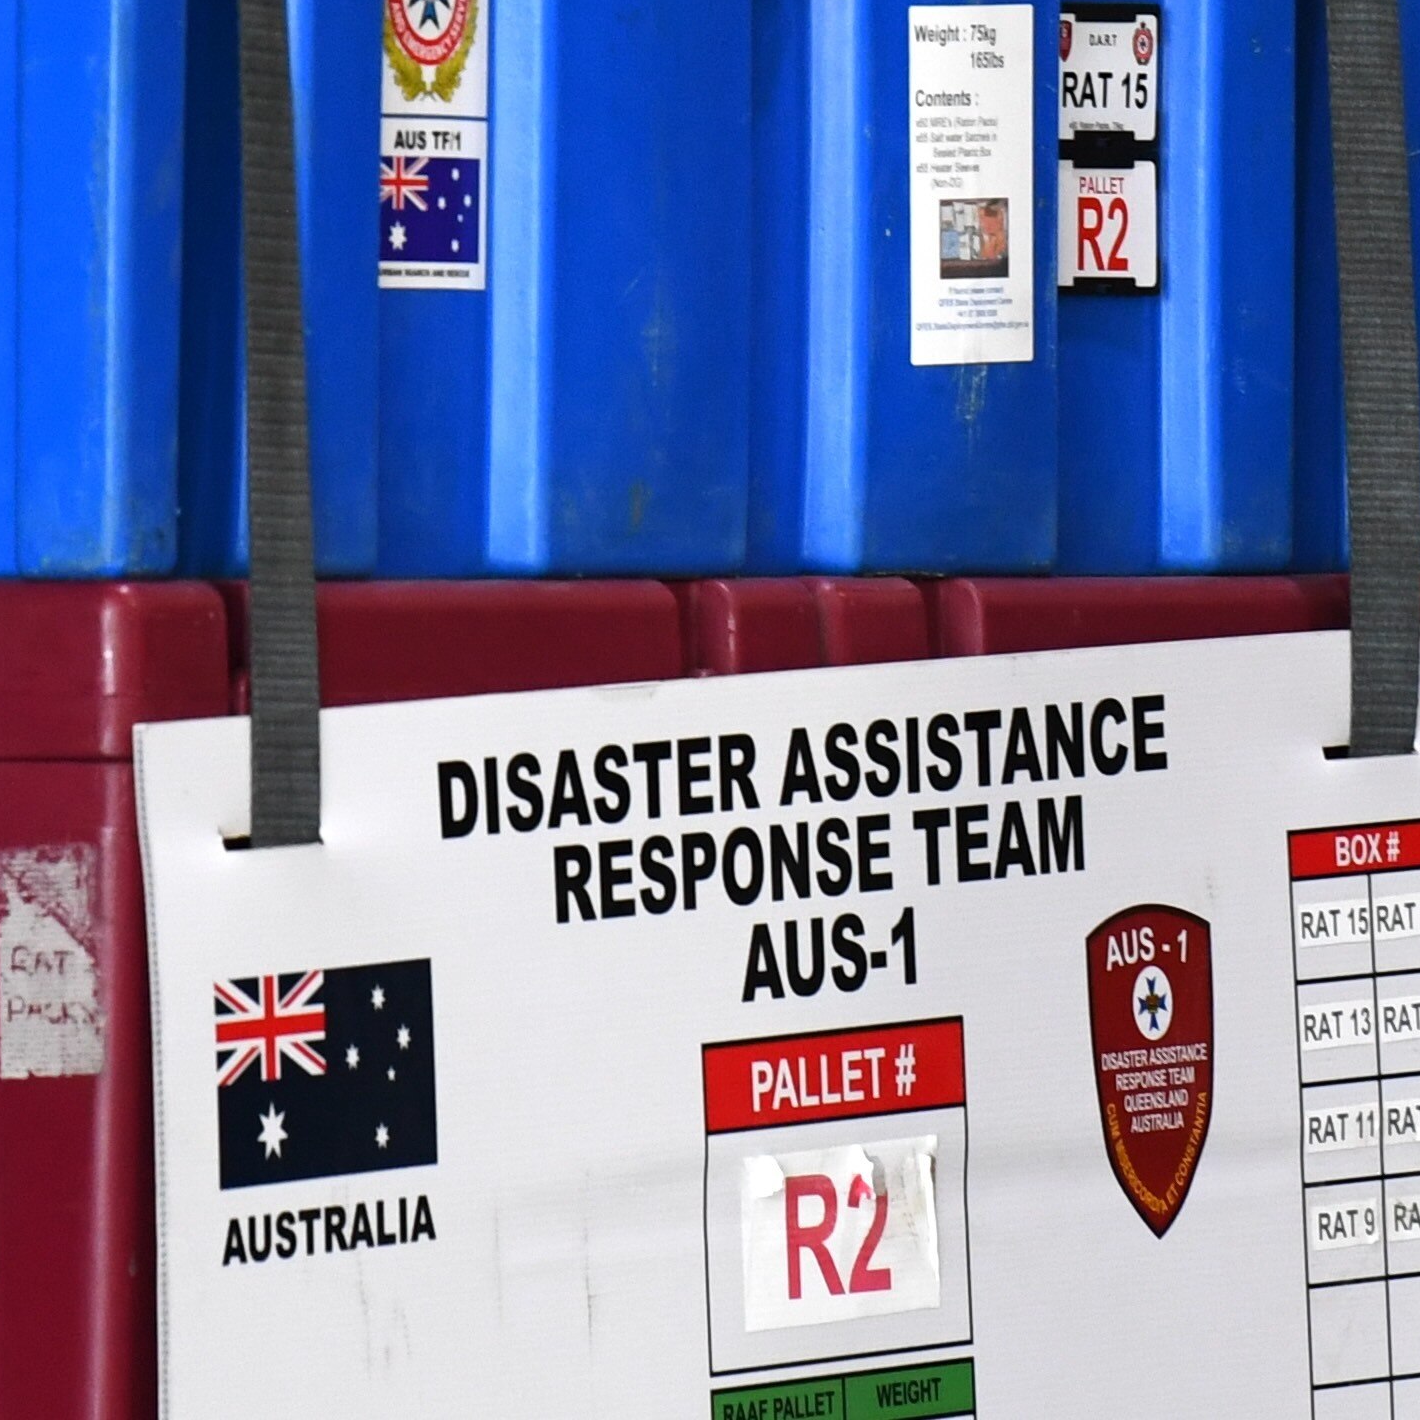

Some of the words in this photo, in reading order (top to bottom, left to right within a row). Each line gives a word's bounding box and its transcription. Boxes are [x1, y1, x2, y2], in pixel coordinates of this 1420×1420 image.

[914, 25, 960, 47] Weight
[970, 24, 997, 47] 75kg
[970, 51, 1005, 69] 165lbs
[915, 89, 972, 107] Contents
[1062, 71, 1113, 108] RAT
[1121, 72, 1148, 109] 15
[394, 130, 427, 150] AUS
[1079, 176, 1125, 195] PALLET
[1077, 196, 1129, 271] R2
[437, 733, 761, 840] DISASTER
[779, 693, 1169, 806] ASSISTANCE
[553, 813, 894, 924] RESPONSE
[913, 794, 1086, 887] TEAM
[1335, 833, 1382, 868] BOX
[1386, 830, 1401, 862] #
[1300, 909, 1341, 940] RAT
[1348, 906, 1369, 936] 15
[1376, 902, 1416, 933] RAT
[741, 906, 918, 1003] AUS-1
[1107, 926, 1155, 972] AUS
[1303, 1010, 1344, 1043] RAT
[1350, 1007, 1372, 1037] 13
[1101, 1049, 1148, 1071] DISASTER
[1149, 1043, 1208, 1066] ASSISTANCE
[750, 1047, 886, 1114] PALLET
[895, 1044, 917, 1097] #
[1115, 1069, 1168, 1092] RESPONSE
[1168, 1066, 1196, 1085] TEAM
[1124, 1089, 1189, 1113] QUEENSLAND
[1130, 1111, 1185, 1133] AUSTRALIA
[1175, 1091, 1208, 1185] CONSTANTIA
[1308, 1113, 1349, 1145] RAT
[1355, 1110, 1376, 1140] 11
[221, 1195, 437, 1267] AUSTRALIA
[784, 1173, 892, 1300] R2
[1318, 1210, 1358, 1241] RAT
[1364, 1207, 1376, 1236] 9
[722, 1399, 768, 1420] RAAF
[773, 1391, 835, 1420] PALLET
[876, 1377, 942, 1409] WEIGHT
